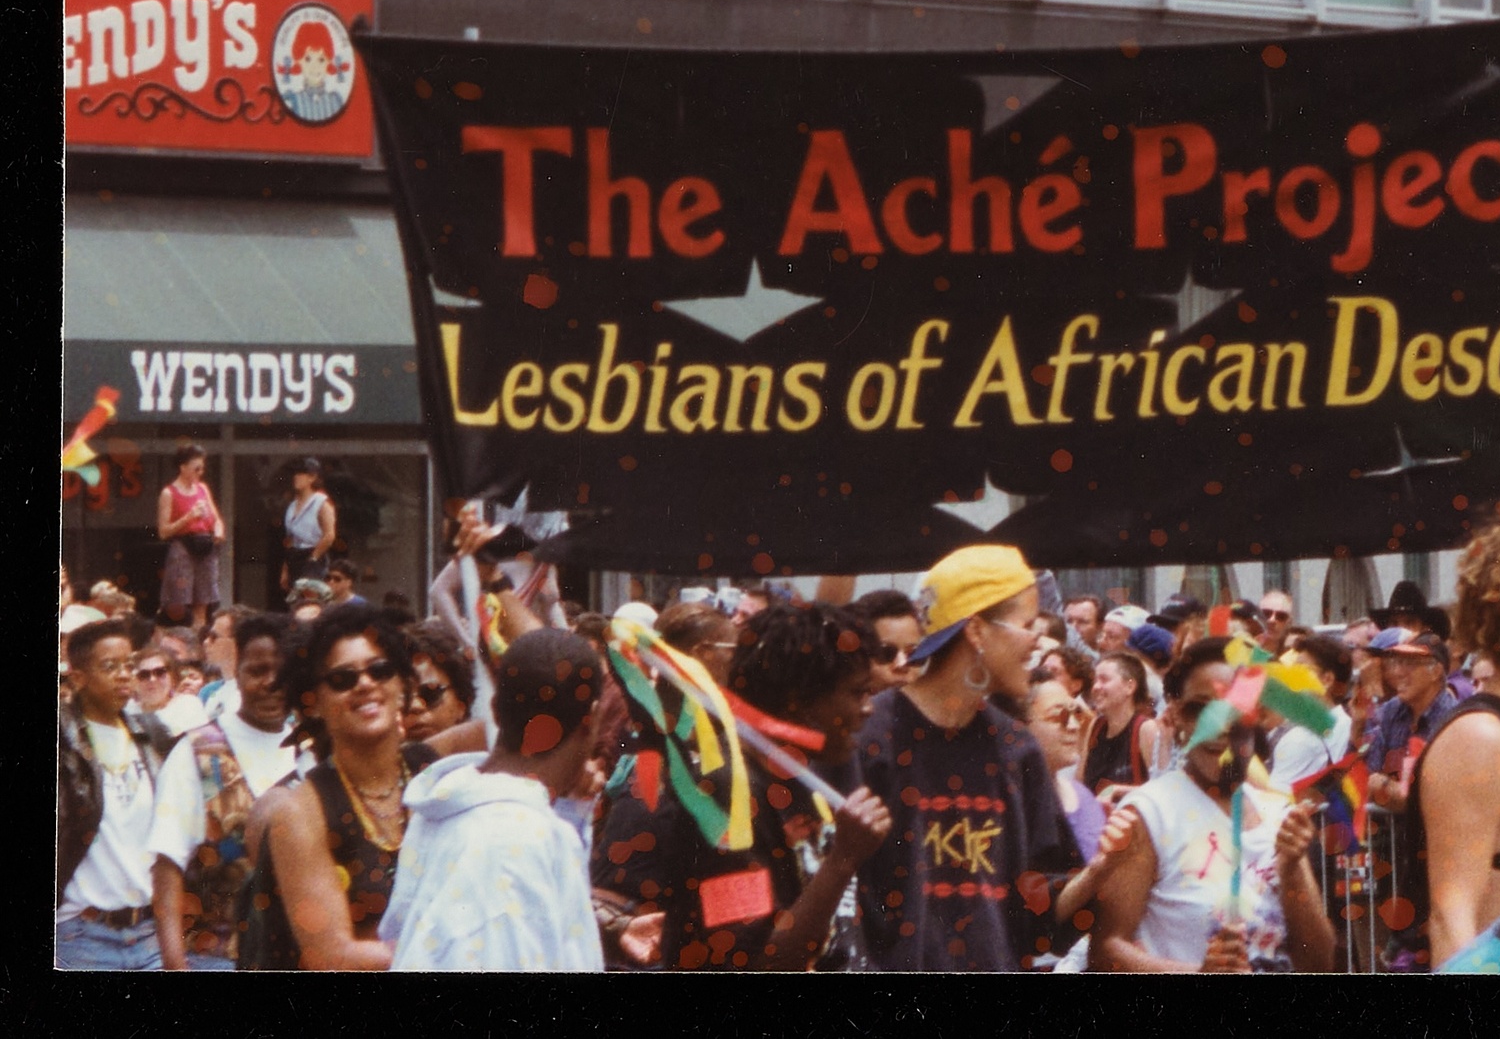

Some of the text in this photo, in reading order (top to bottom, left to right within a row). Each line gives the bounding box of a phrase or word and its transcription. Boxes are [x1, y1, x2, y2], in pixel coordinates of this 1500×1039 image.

[461, 125, 726, 258] The
[777, 127, 1086, 256] Aché
[439, 322, 828, 434] Lesbians
[845, 318, 949, 432] of
[952, 314, 1309, 426] African
